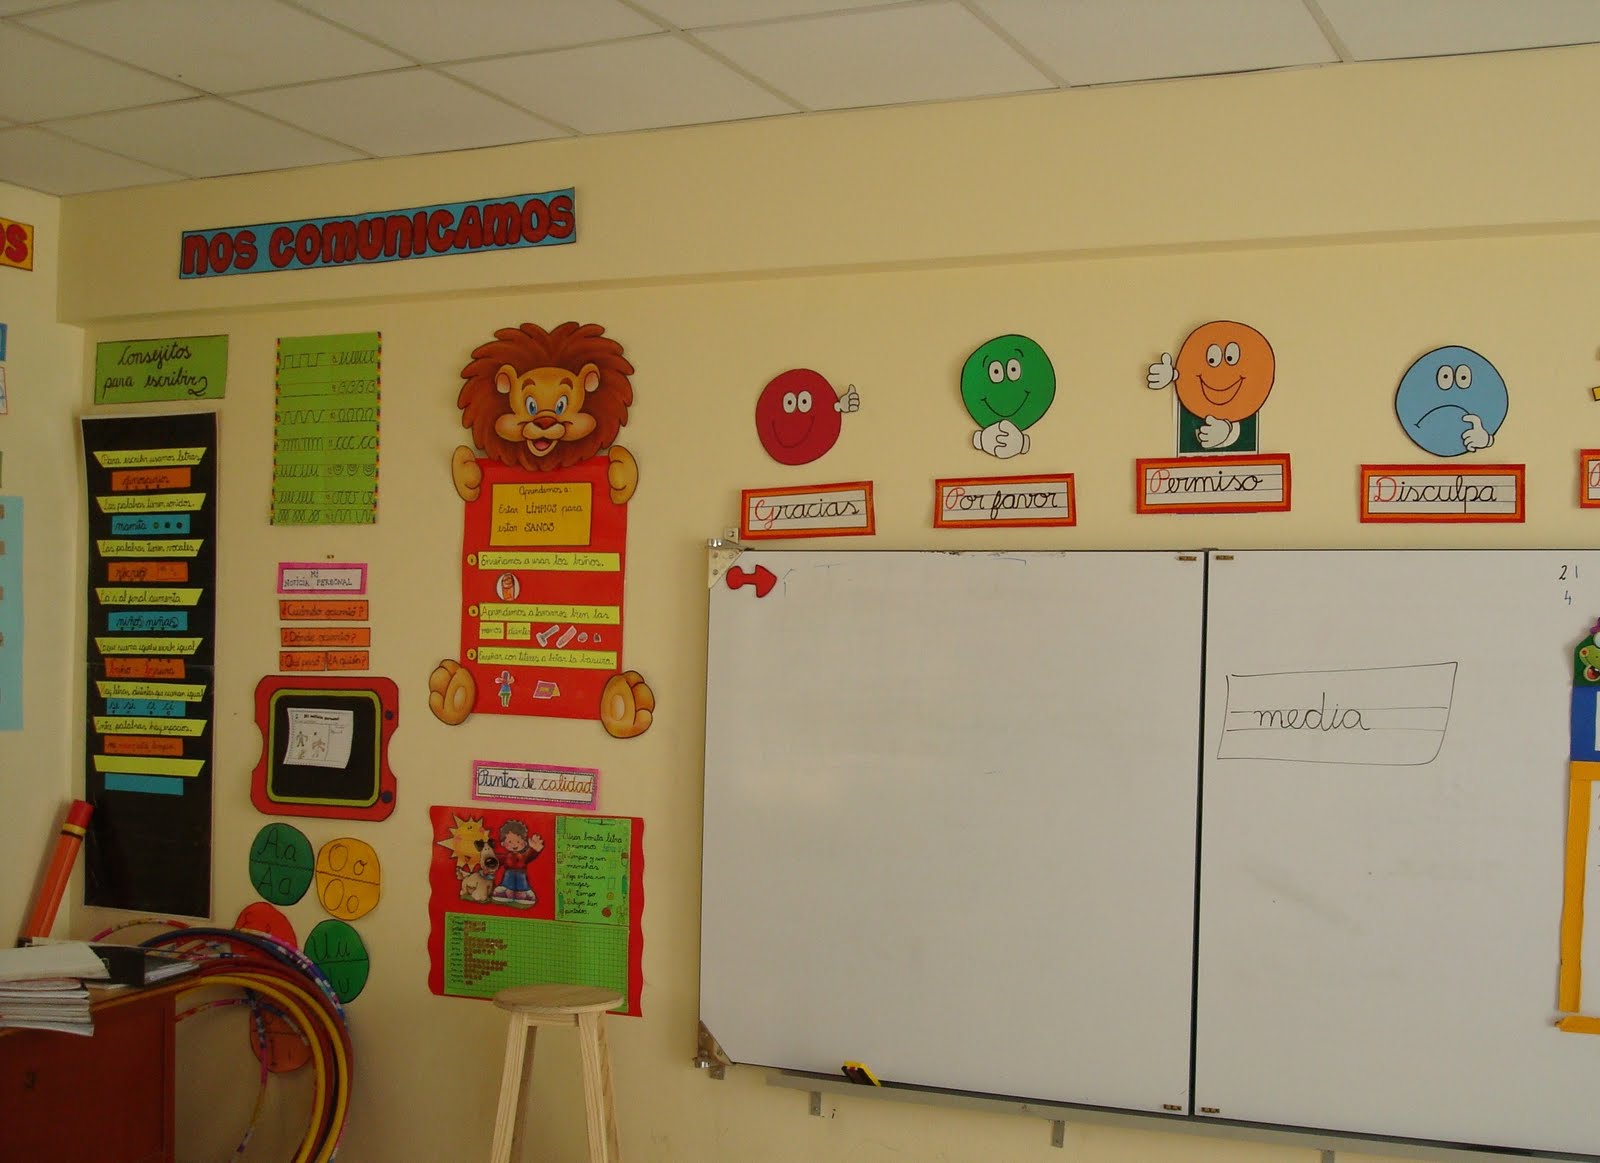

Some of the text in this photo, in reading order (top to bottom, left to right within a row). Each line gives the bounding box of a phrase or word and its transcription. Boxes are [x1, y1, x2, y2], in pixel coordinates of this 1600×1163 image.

[0, 223, 28, 263] S
[182, 195, 574, 274] NOS COMUNICAMOS
[118, 342, 191, 369] Consejitos
[102, 367, 206, 399] para escribir
[1149, 469, 1263, 494] Permiso
[1374, 475, 1498, 514] Disculpa
[755, 498, 860, 531] Gracias
[945, 487, 1058, 520] Por favor
[524, 522, 555, 532] SANOS
[1564, 590, 1572, 605] 4
[1253, 692, 1371, 732] media
[477, 769, 594, 794] Puntos de calidad
